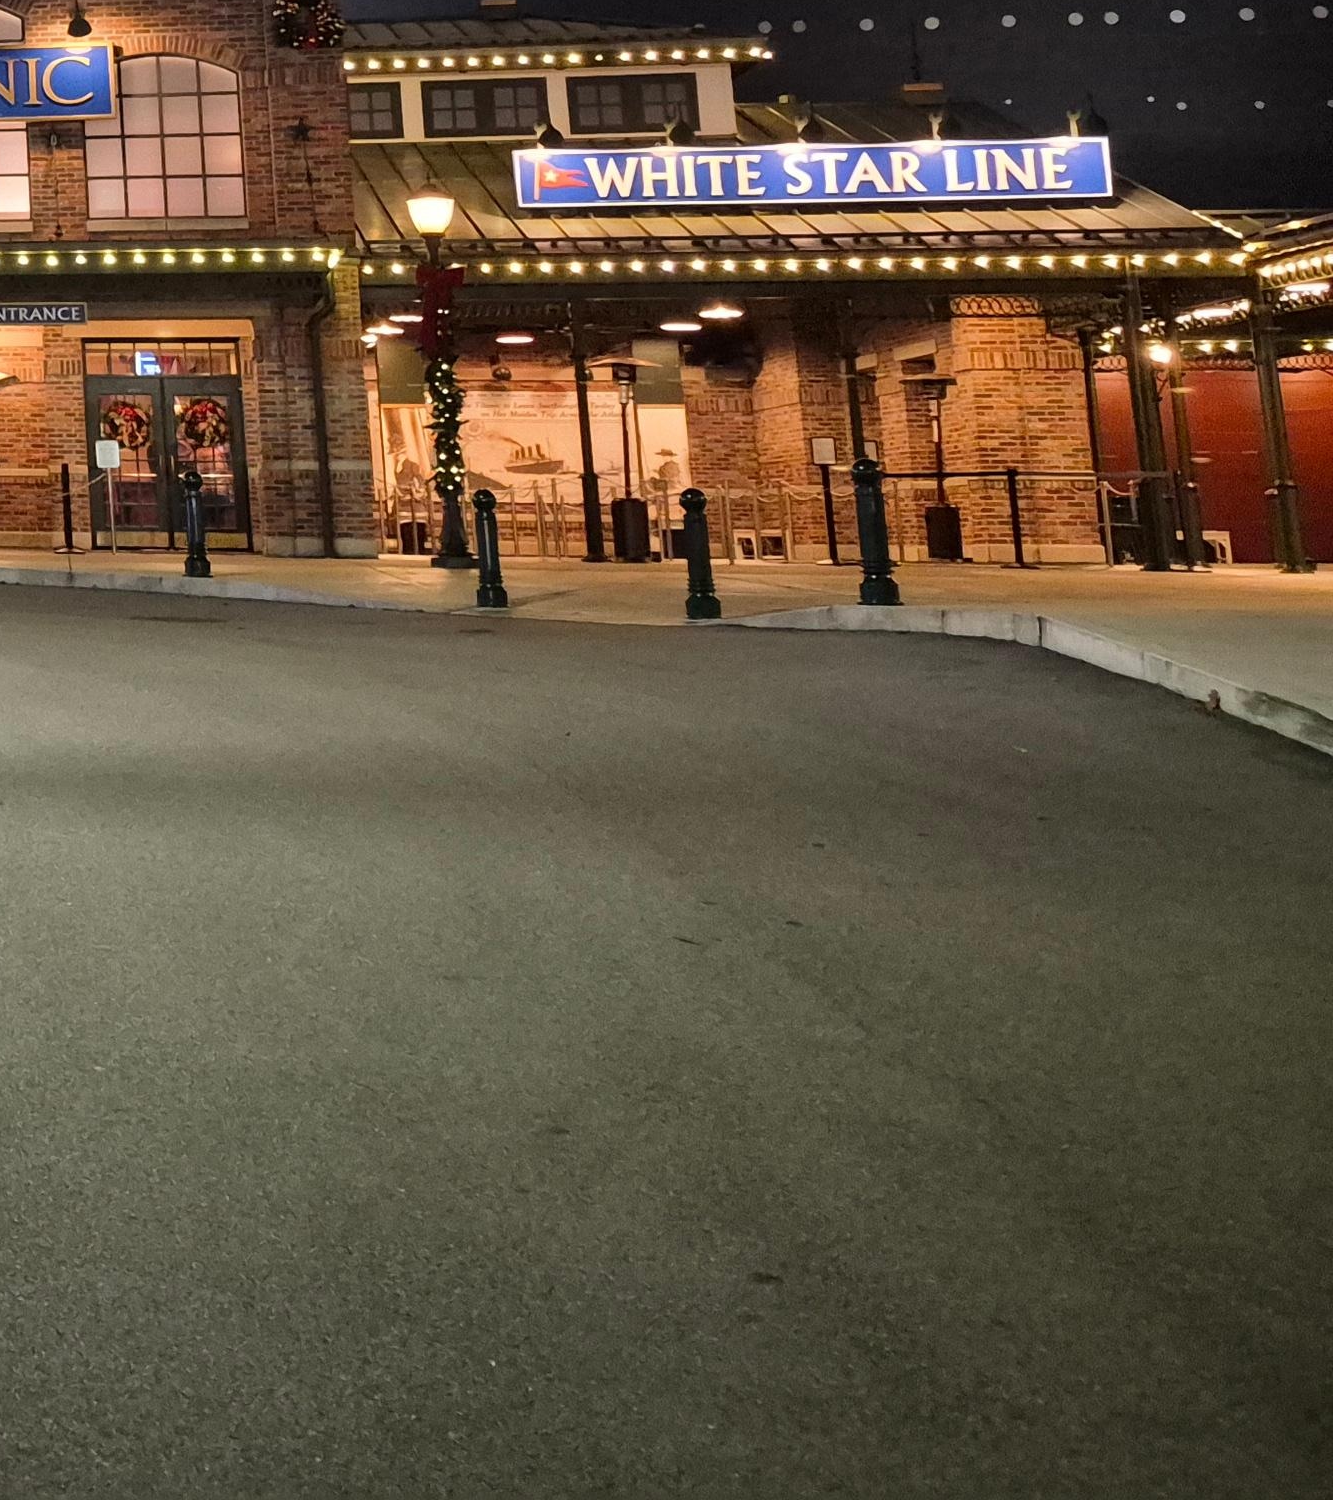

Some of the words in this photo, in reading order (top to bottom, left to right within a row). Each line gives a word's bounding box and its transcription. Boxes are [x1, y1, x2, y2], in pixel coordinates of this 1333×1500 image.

[584, 154, 766, 198] WHITE
[783, 150, 928, 196] STAR
[942, 147, 1074, 192] LINE
